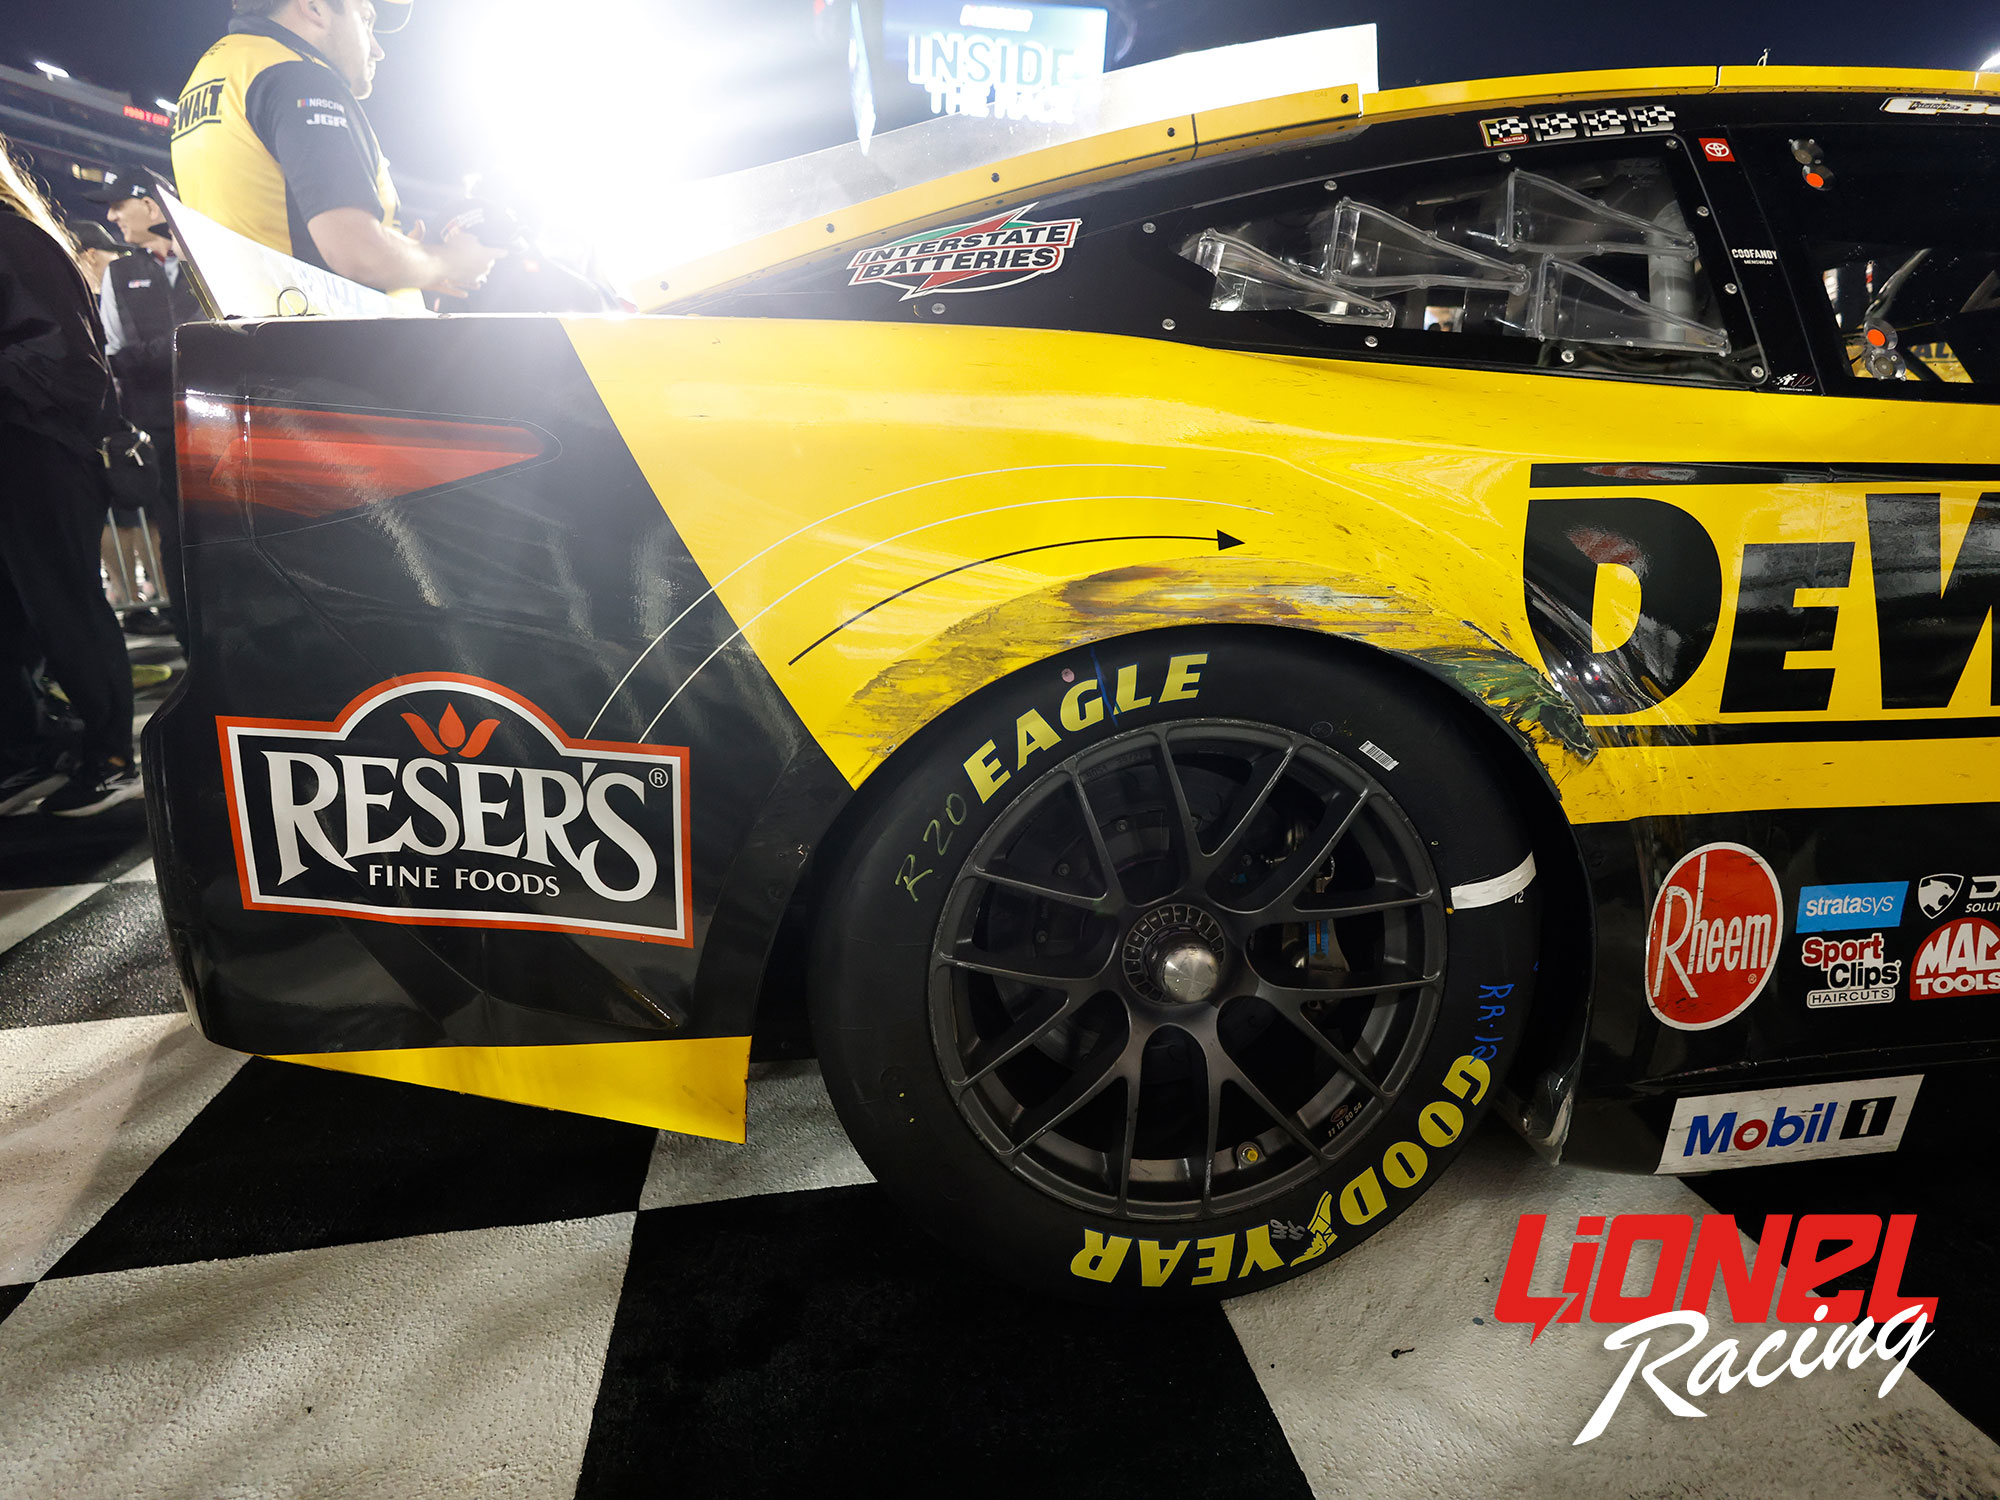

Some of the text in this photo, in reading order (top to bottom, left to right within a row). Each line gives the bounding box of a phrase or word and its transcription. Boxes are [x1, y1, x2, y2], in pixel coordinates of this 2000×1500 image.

[907, 32, 1076, 86] INSIDE
[306, 113, 348, 128] JGR
[857, 225, 1069, 264] INTERSTATE
[1731, 248, 1778, 260] COOFANDY
[861, 247, 1057, 279] BATTERIES
[963, 652, 1209, 804] EAGLE
[259, 750, 658, 904] RESER'S
[368, 864, 562, 898] FINE FOODS
[1805, 895, 1894, 917] stratasys
[1652, 853, 1772, 999] Rheem
[1802, 935, 1882, 969] Sport
[1916, 922, 2000, 976] MAC
[1829, 961, 1898, 989] Clips
[1916, 971, 2000, 996] TOOLS
[1812, 989, 1890, 1004] HAIRCUTS
[1683, 1100, 1879, 1157] Mobil 1
